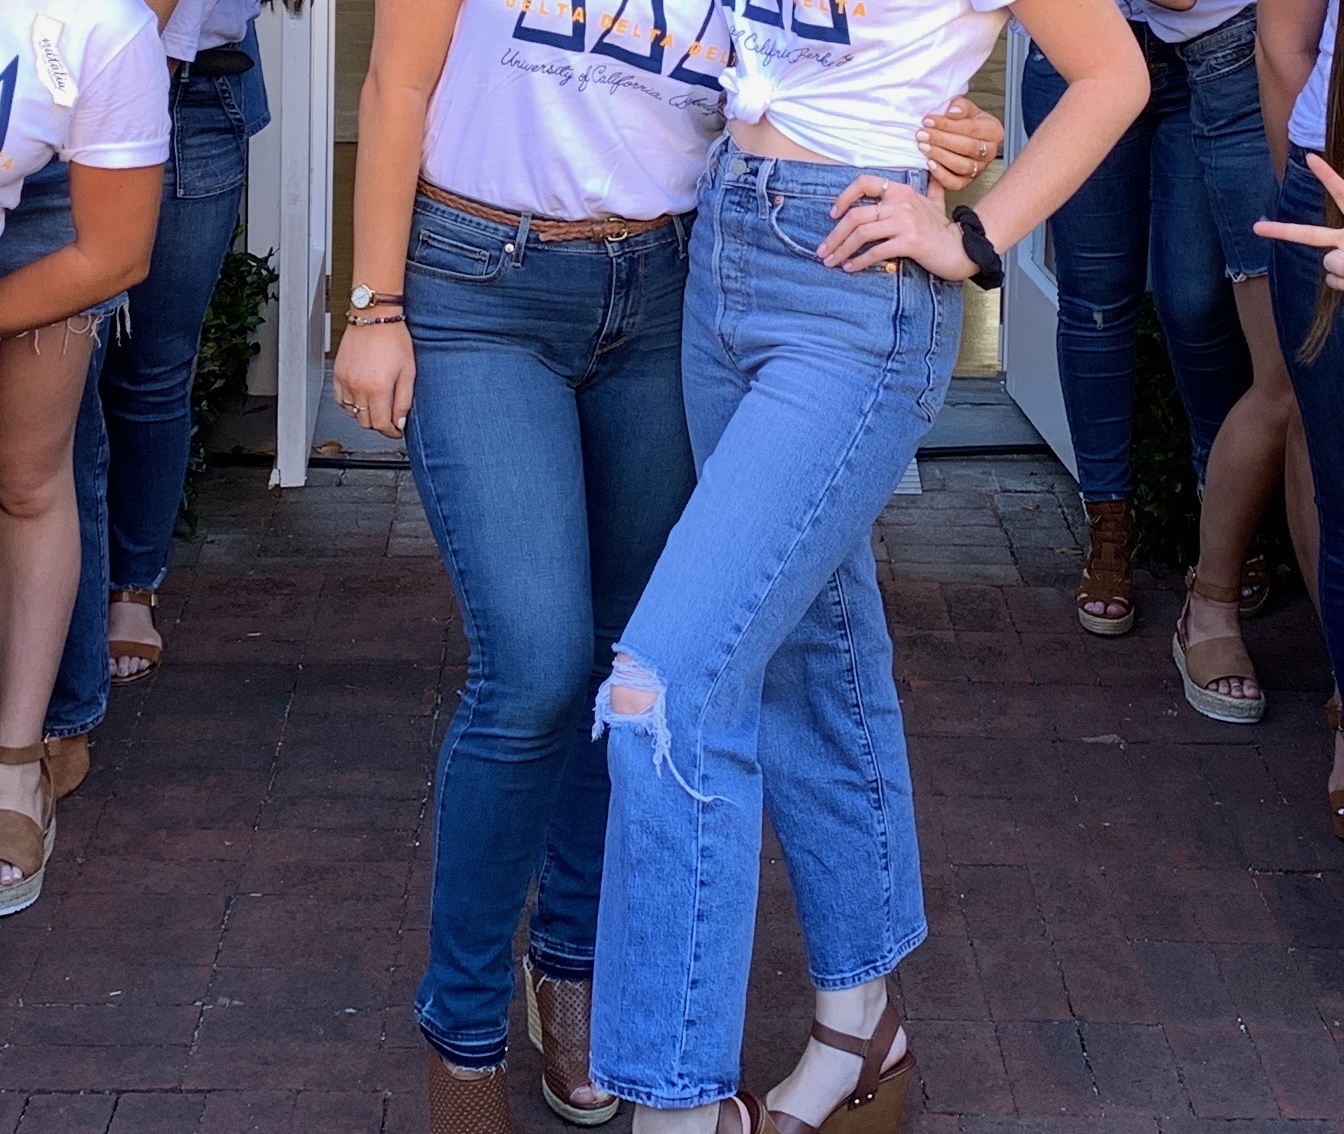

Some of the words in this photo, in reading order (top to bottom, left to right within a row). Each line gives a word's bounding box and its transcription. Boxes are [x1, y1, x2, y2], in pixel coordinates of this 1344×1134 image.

[599, 12, 674, 49] DELTA
[500, 48, 574, 87] University
[578, 65, 593, 92] of
